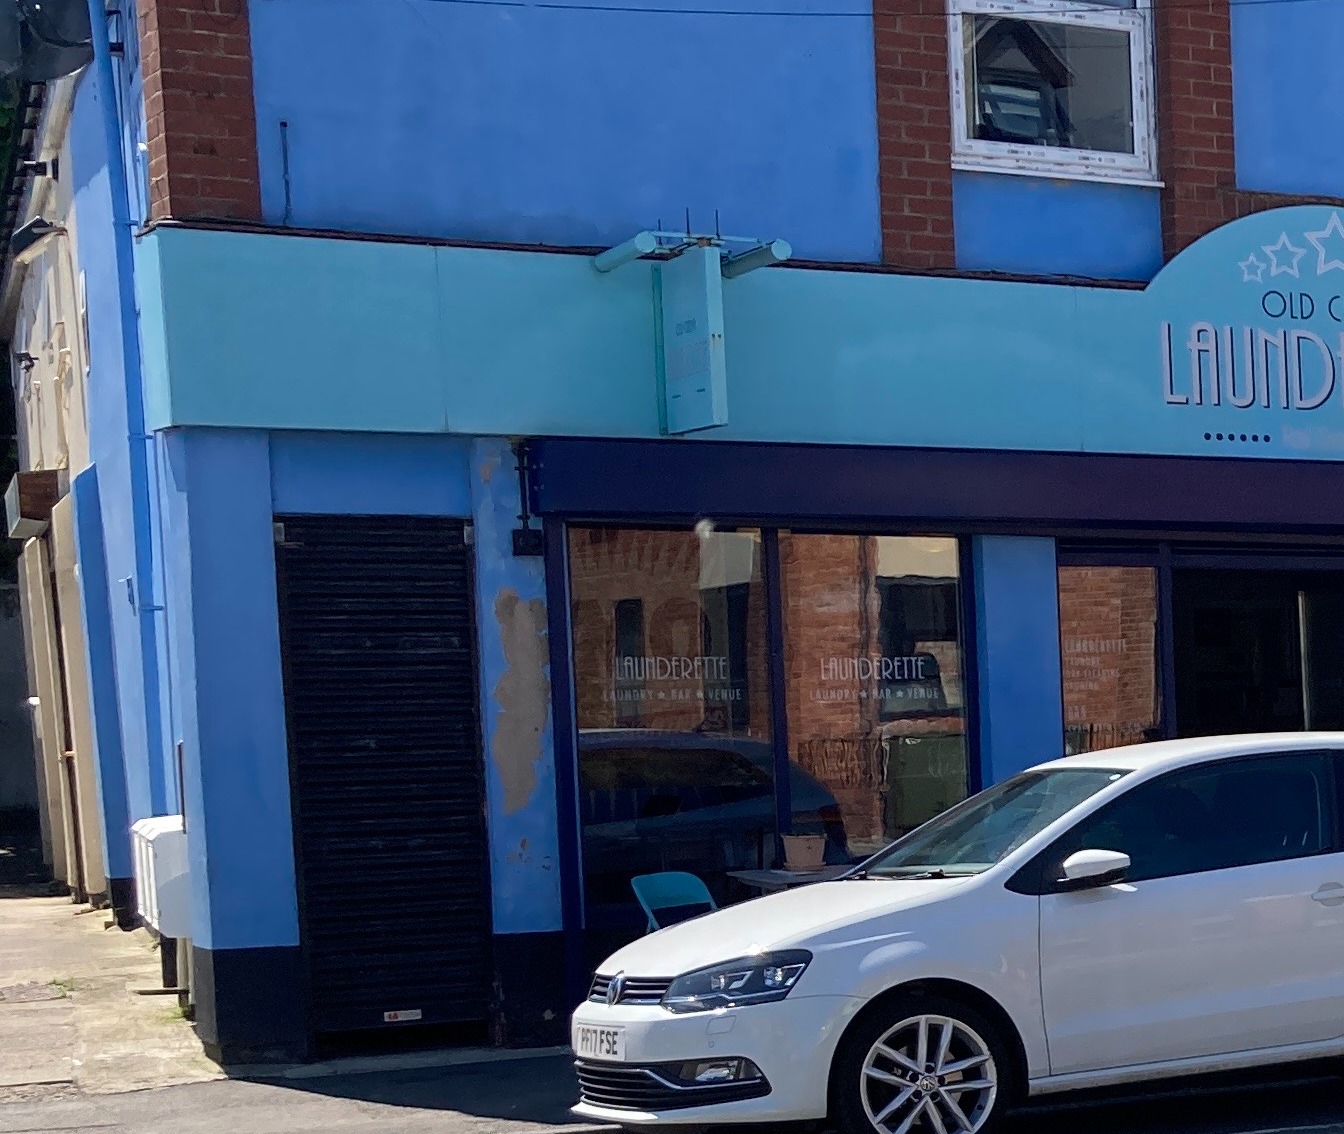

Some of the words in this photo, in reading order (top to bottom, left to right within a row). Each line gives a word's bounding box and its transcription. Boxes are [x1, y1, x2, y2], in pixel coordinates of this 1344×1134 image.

[1262, 290, 1315, 320] OLD
[615, 656, 728, 681] LAUNDERETTE
[820, 656, 926, 681] LAUNDERETTE
[602, 688, 653, 701] LAUNDRY
[671, 688, 691, 700] BAR
[708, 688, 742, 701] VENUE
[810, 688, 857, 701] LAUNDRY
[872, 688, 892, 700] BAR
[907, 687, 939, 700] VENUE
[599, 1029, 619, 1055] FSE
